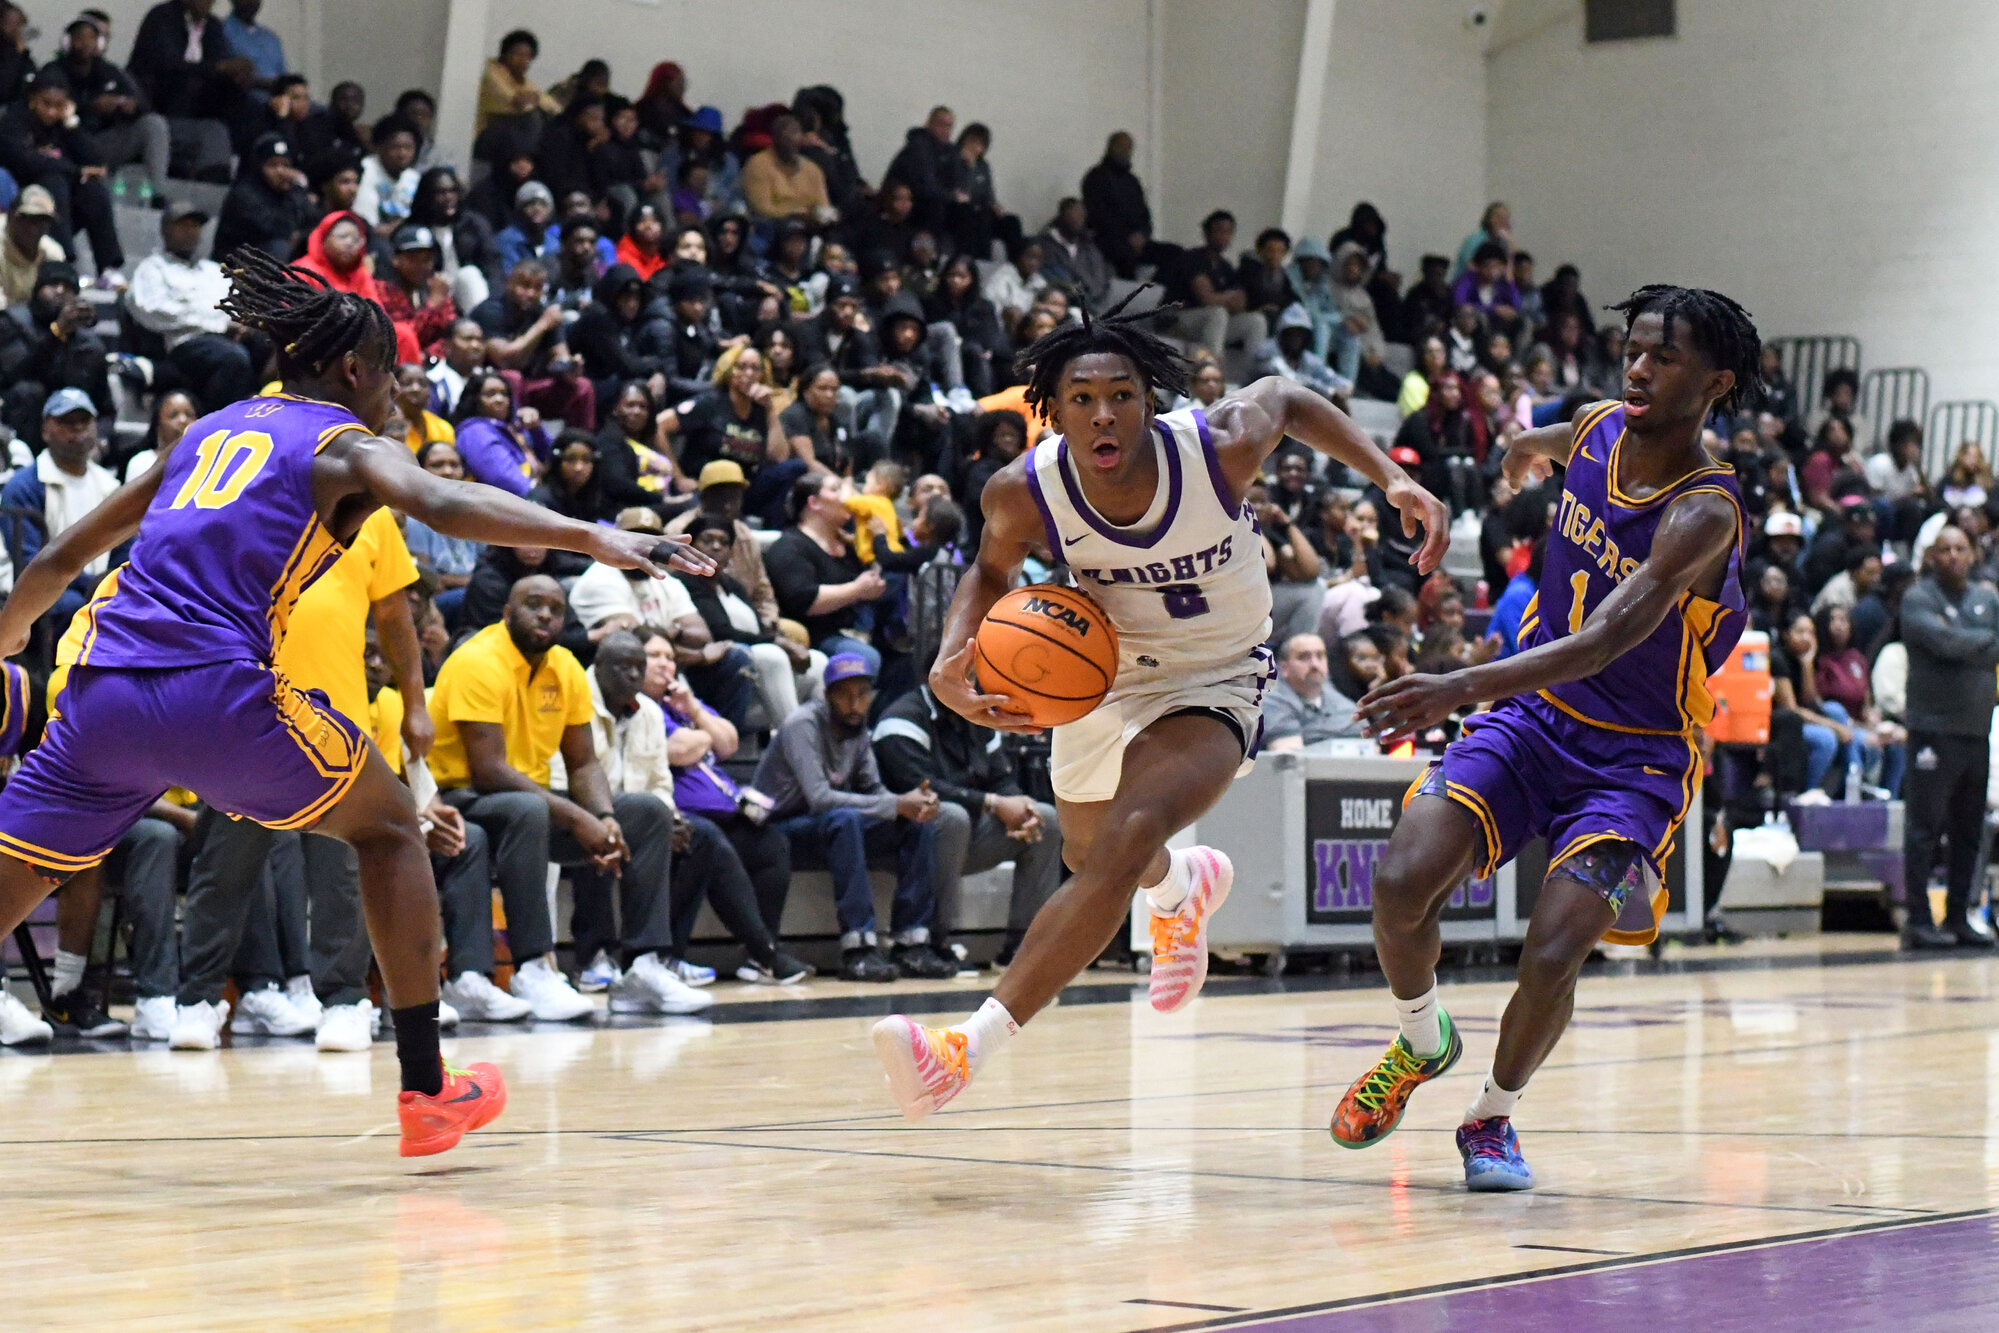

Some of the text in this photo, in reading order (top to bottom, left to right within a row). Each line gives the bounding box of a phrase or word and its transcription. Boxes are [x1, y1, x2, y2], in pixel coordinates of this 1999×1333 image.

[168, 429, 275, 510] 10
[1558, 488, 1640, 585] TIGERS
[1022, 597, 1091, 637] NCAA
[1568, 569, 1591, 635] 1
[1011, 643, 1050, 684] G
[1340, 798, 1393, 829] HOME
